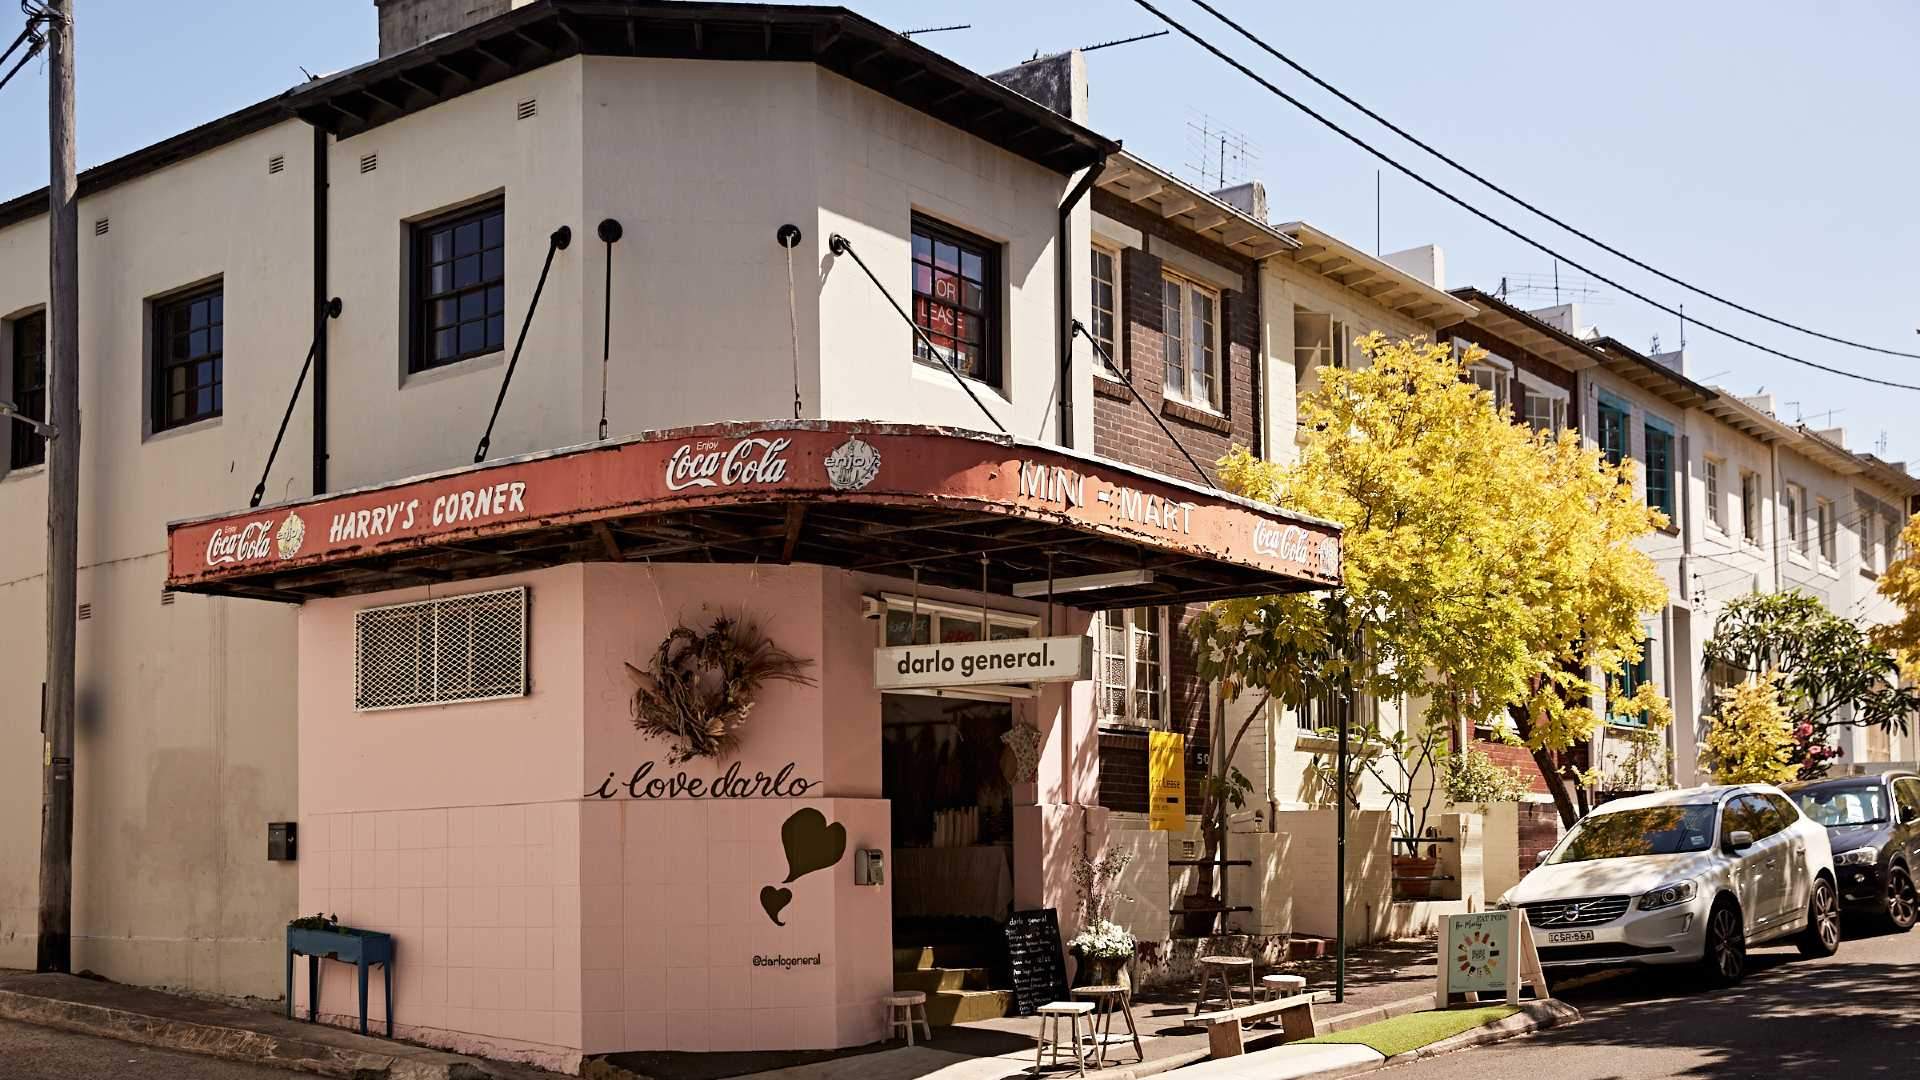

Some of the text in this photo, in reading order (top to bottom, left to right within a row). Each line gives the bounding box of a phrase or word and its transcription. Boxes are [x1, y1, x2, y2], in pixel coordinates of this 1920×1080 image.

[921, 299, 964, 329] LEASE
[665, 437, 791, 491] Coca-Cola
[696, 441, 719, 451] Enjoy
[329, 481, 527, 543] HARRY'S CORNER
[1019, 459, 1084, 508] MINI
[1121, 486, 1195, 535] MART
[206, 520, 274, 566] Coca-Cola
[1253, 520, 1309, 565] Coca-Cola
[897, 642, 1055, 677] darlo general.
[622, 761, 708, 799] love
[710, 761, 825, 798] darlo
[752, 953, 821, 970] @darlogeneral
